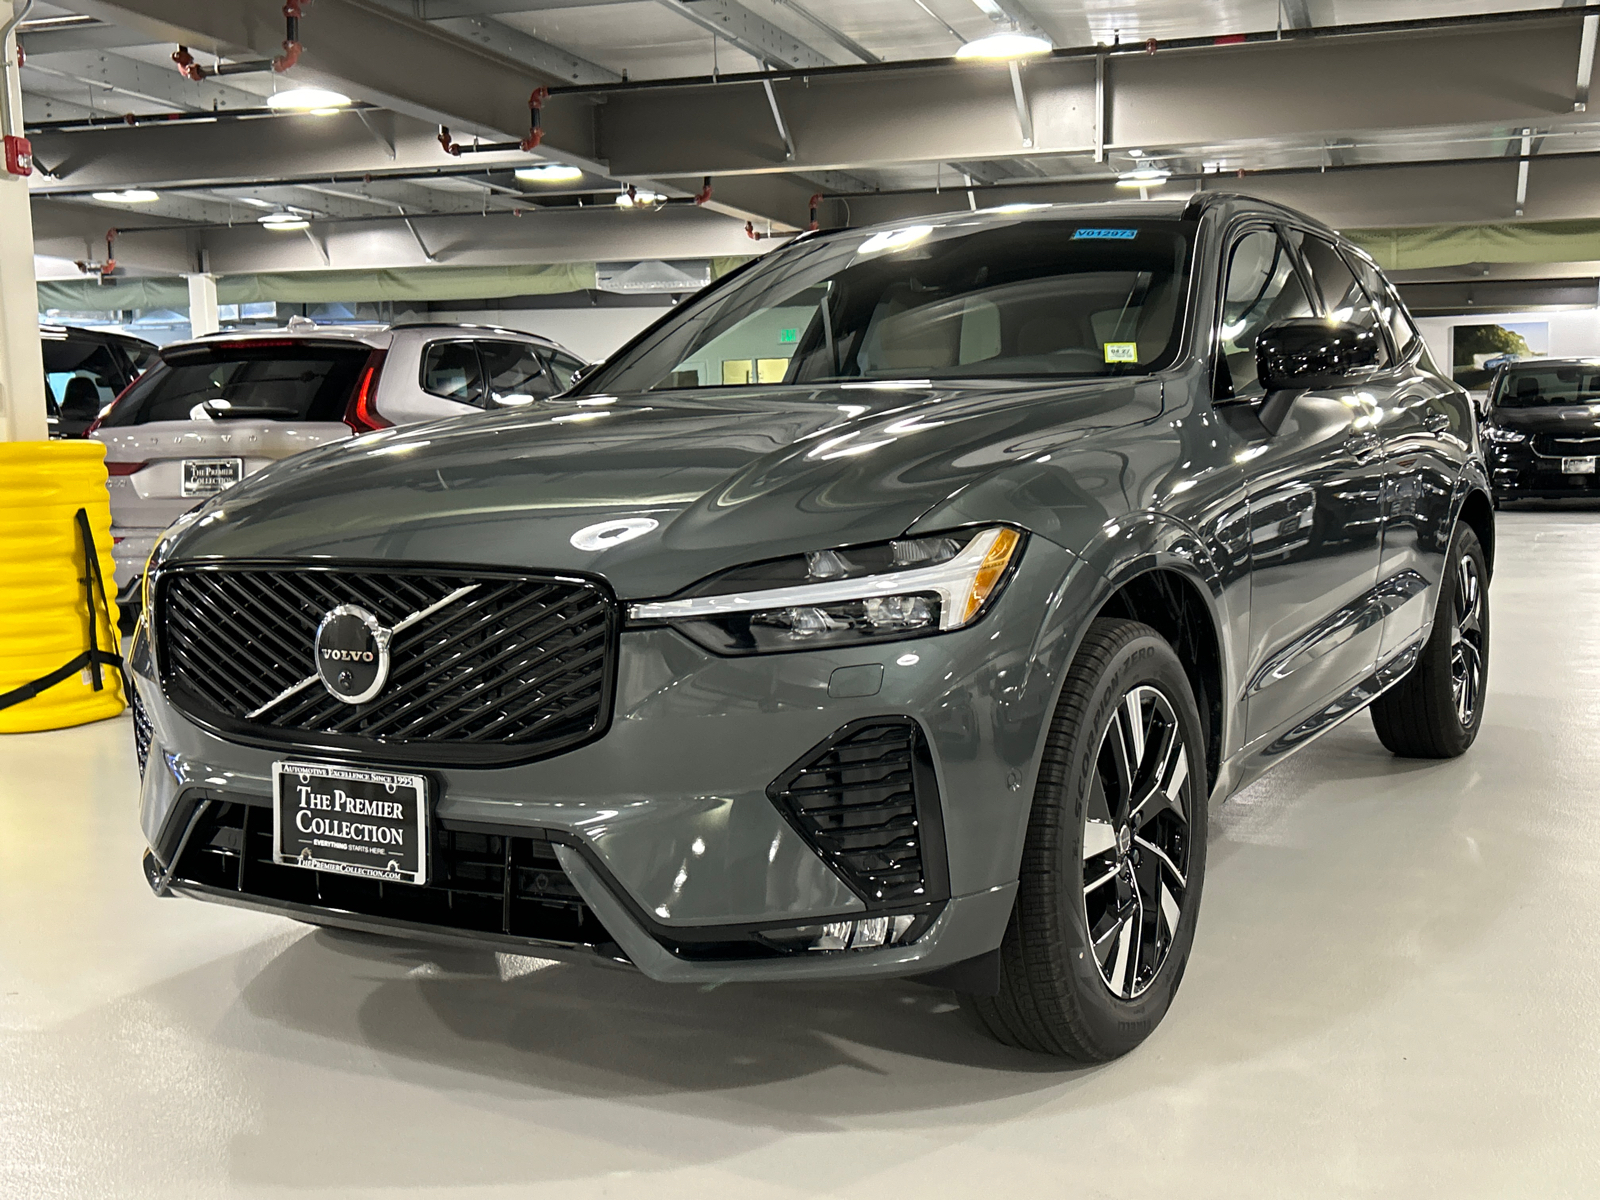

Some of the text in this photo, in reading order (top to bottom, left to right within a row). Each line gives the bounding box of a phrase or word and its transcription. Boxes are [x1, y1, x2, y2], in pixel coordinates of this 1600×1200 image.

[321, 648, 374, 662] VOLVO
[1124, 645, 1155, 674] ZERO
[283, 764, 413, 786] AUTOMOTIVE EXCELLENCE SINCE 1995
[296, 785, 404, 820] THE PREMIER
[295, 809, 404, 846] COLLECTION
[313, 838, 348, 851] EVERYTHING
[348, 844, 369, 854] STARTS
